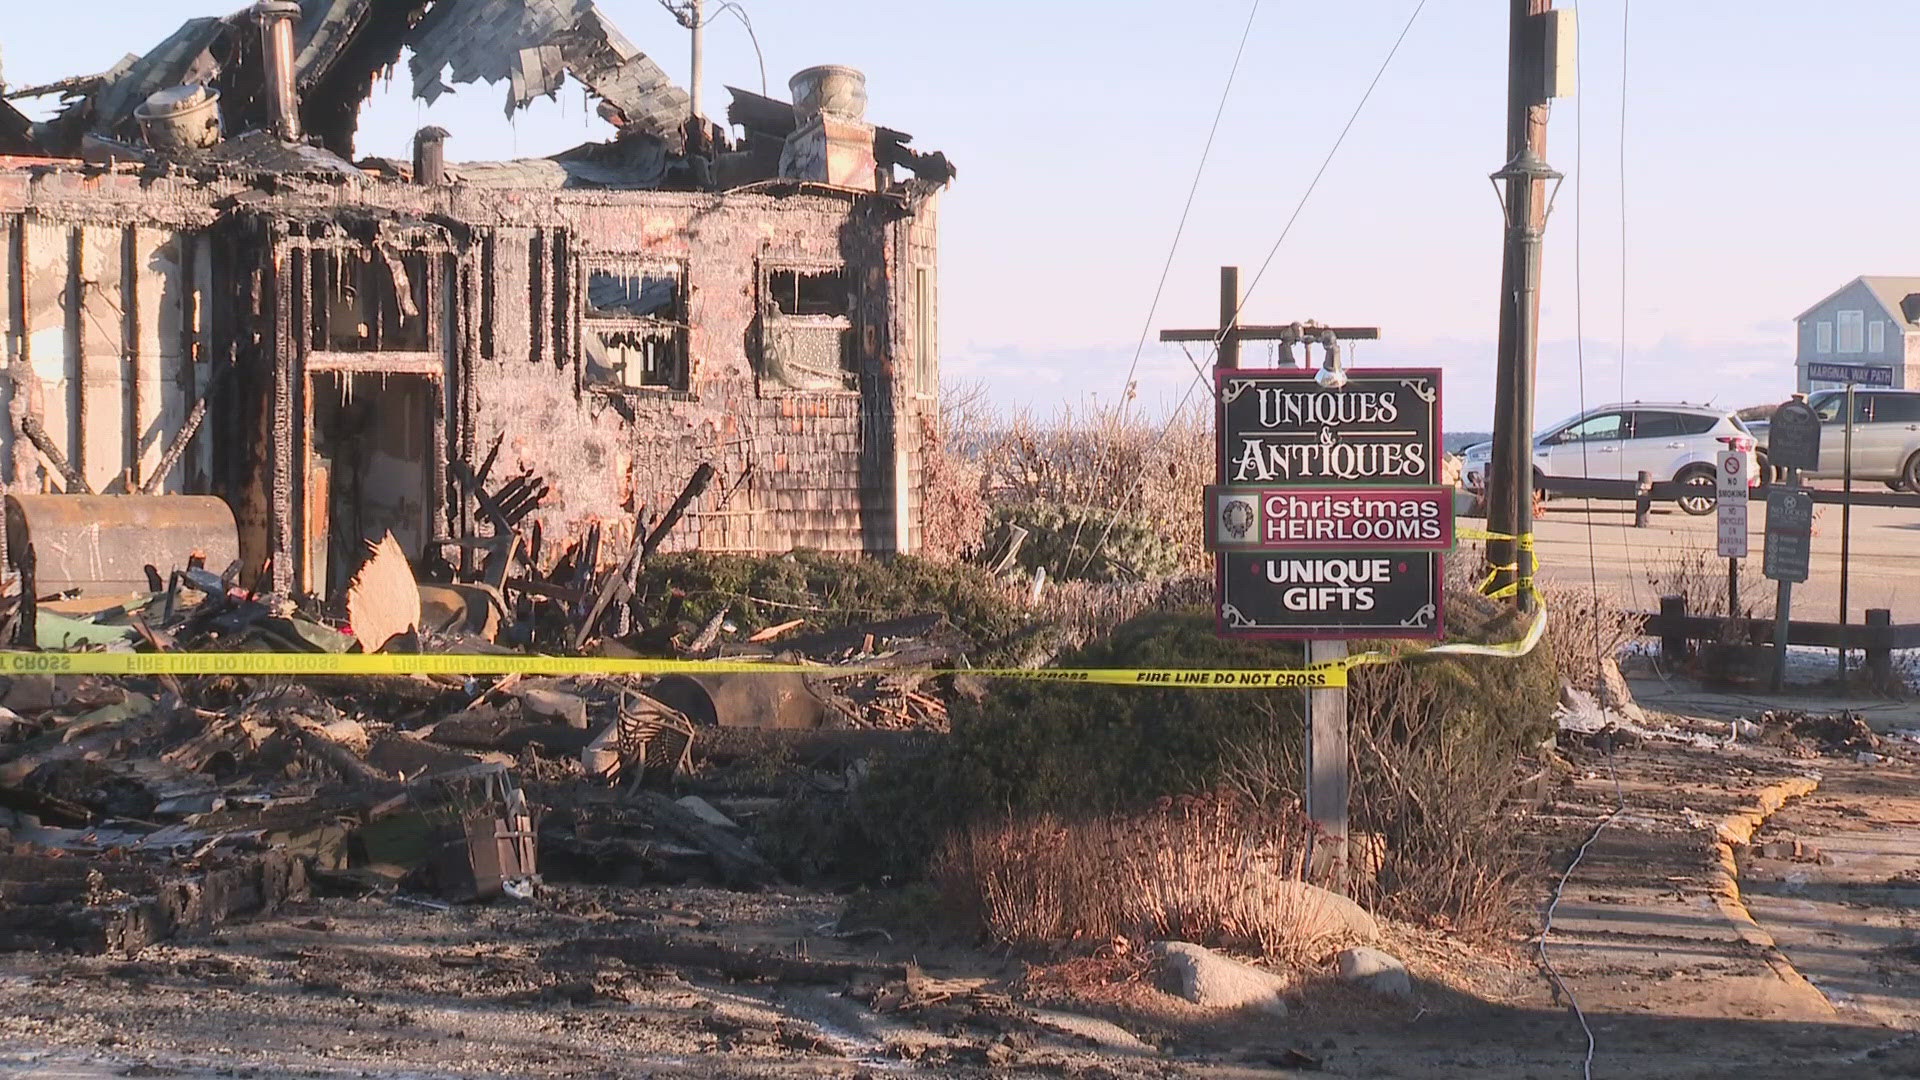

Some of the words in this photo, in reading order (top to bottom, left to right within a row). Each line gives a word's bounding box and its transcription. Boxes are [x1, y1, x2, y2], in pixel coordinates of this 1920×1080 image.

[1809, 364, 1849, 379] MARGINAL
[1851, 367, 1869, 381] WAY
[1871, 369, 1891, 383] PATH
[1320, 427, 1336, 444] &
[1727, 477, 1738, 486] NO
[1718, 490, 1747, 498] SMOKING
[1265, 496, 1439, 518] Christmas
[1266, 518, 1441, 540] HEIRLOOMS
[1266, 559, 1391, 587] UNIQUE
[1283, 587, 1375, 612] GIFTS
[1136, 672, 1171, 682] FIRE
[1174, 673, 1209, 683] LINE
[1213, 673, 1236, 684] DO
[1239, 673, 1272, 685] NOT
[1275, 674, 1326, 686] CROSS
